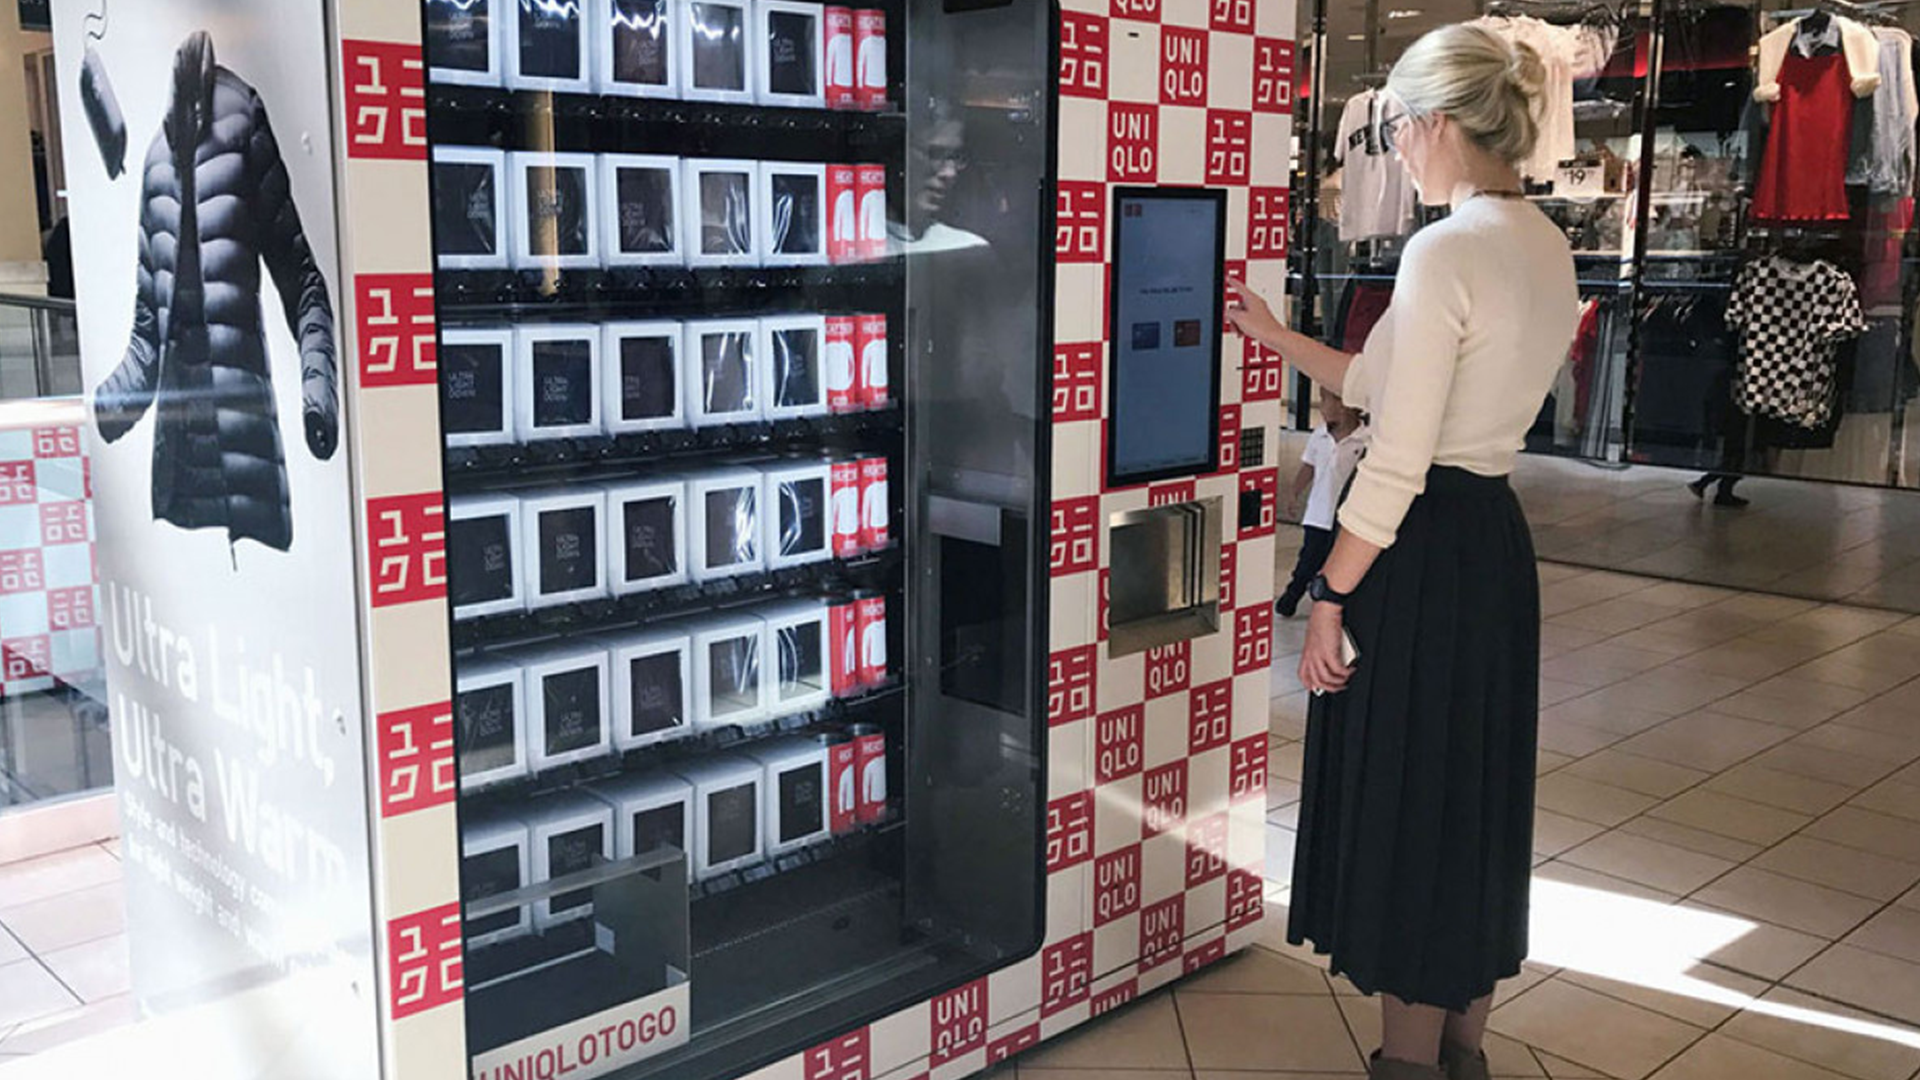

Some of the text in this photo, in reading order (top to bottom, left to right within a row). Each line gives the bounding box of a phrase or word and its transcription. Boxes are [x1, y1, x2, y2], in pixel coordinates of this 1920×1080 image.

[1165, 35, 1201, 65] UNI
[1163, 68, 1203, 99] QLO
[1112, 112, 1150, 140] UNI
[1111, 145, 1153, 176] QLO
[109, 580, 335, 789] Ultra Light,
[1149, 659, 1186, 693] QLO
[1100, 715, 1136, 745] UNI
[1099, 743, 1139, 778] QLO
[118, 691, 349, 896] Ultra Warm
[1147, 768, 1181, 799] UNI
[1146, 796, 1183, 832] QLO
[1099, 854, 1135, 886] UNI
[1098, 881, 1137, 918] QLO
[1145, 903, 1178, 936] UNI
[936, 986, 979, 1025] UNI
